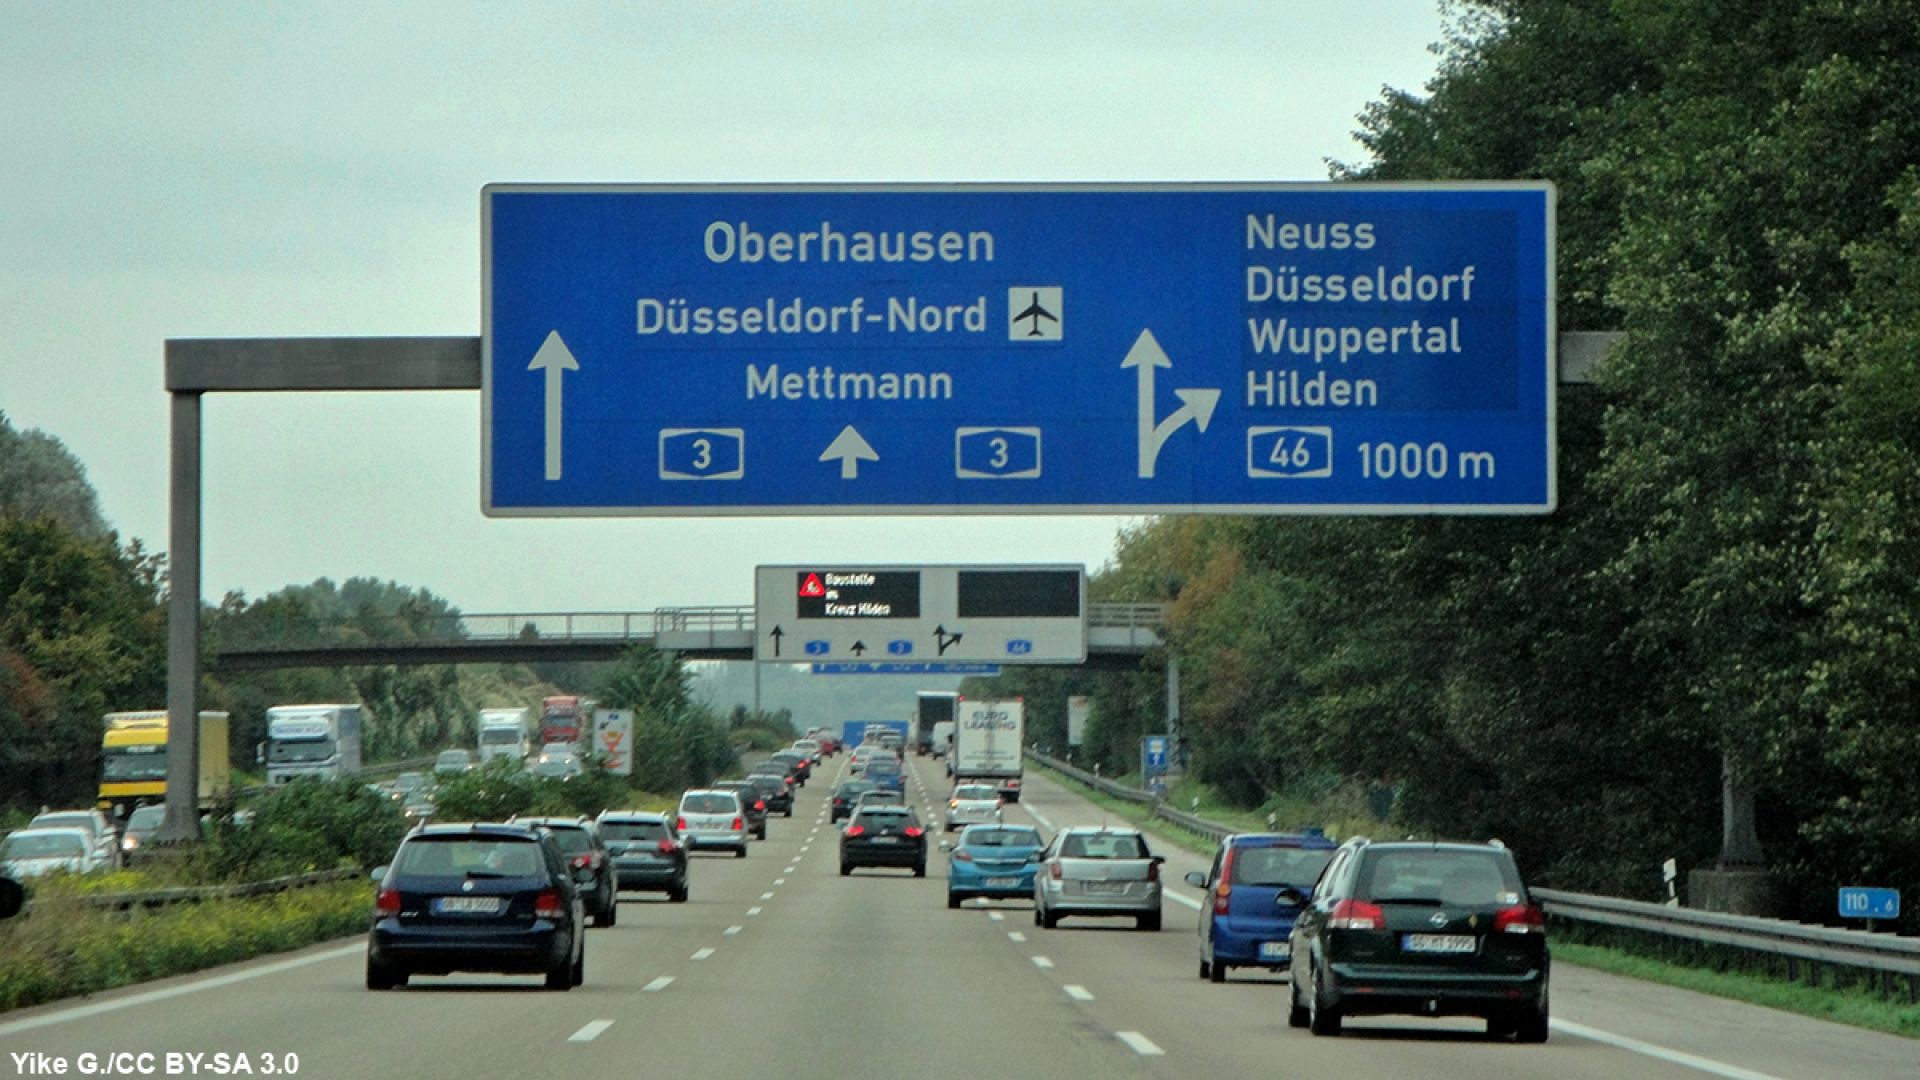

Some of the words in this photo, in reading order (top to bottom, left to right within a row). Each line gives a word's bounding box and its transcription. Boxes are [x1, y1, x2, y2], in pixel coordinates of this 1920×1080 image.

[704, 221, 994, 263] Oberhausen
[1246, 215, 1376, 249] Neuss
[1246, 266, 1474, 303] Düsseldorf
[637, 297, 986, 335] Düsseldorf-Nord
[1248, 318, 1461, 362] Wuppertal
[746, 364, 952, 400] Mettmann
[1246, 370, 1378, 407] Hilden
[692, 439, 711, 470] 3
[989, 438, 1008, 469] 3
[1270, 437, 1310, 468] 46
[1358, 442, 1447, 479] 1000
[1459, 452, 1495, 479] m
[825, 572, 876, 585] Baustelle
[825, 602, 856, 615] Kreuz
